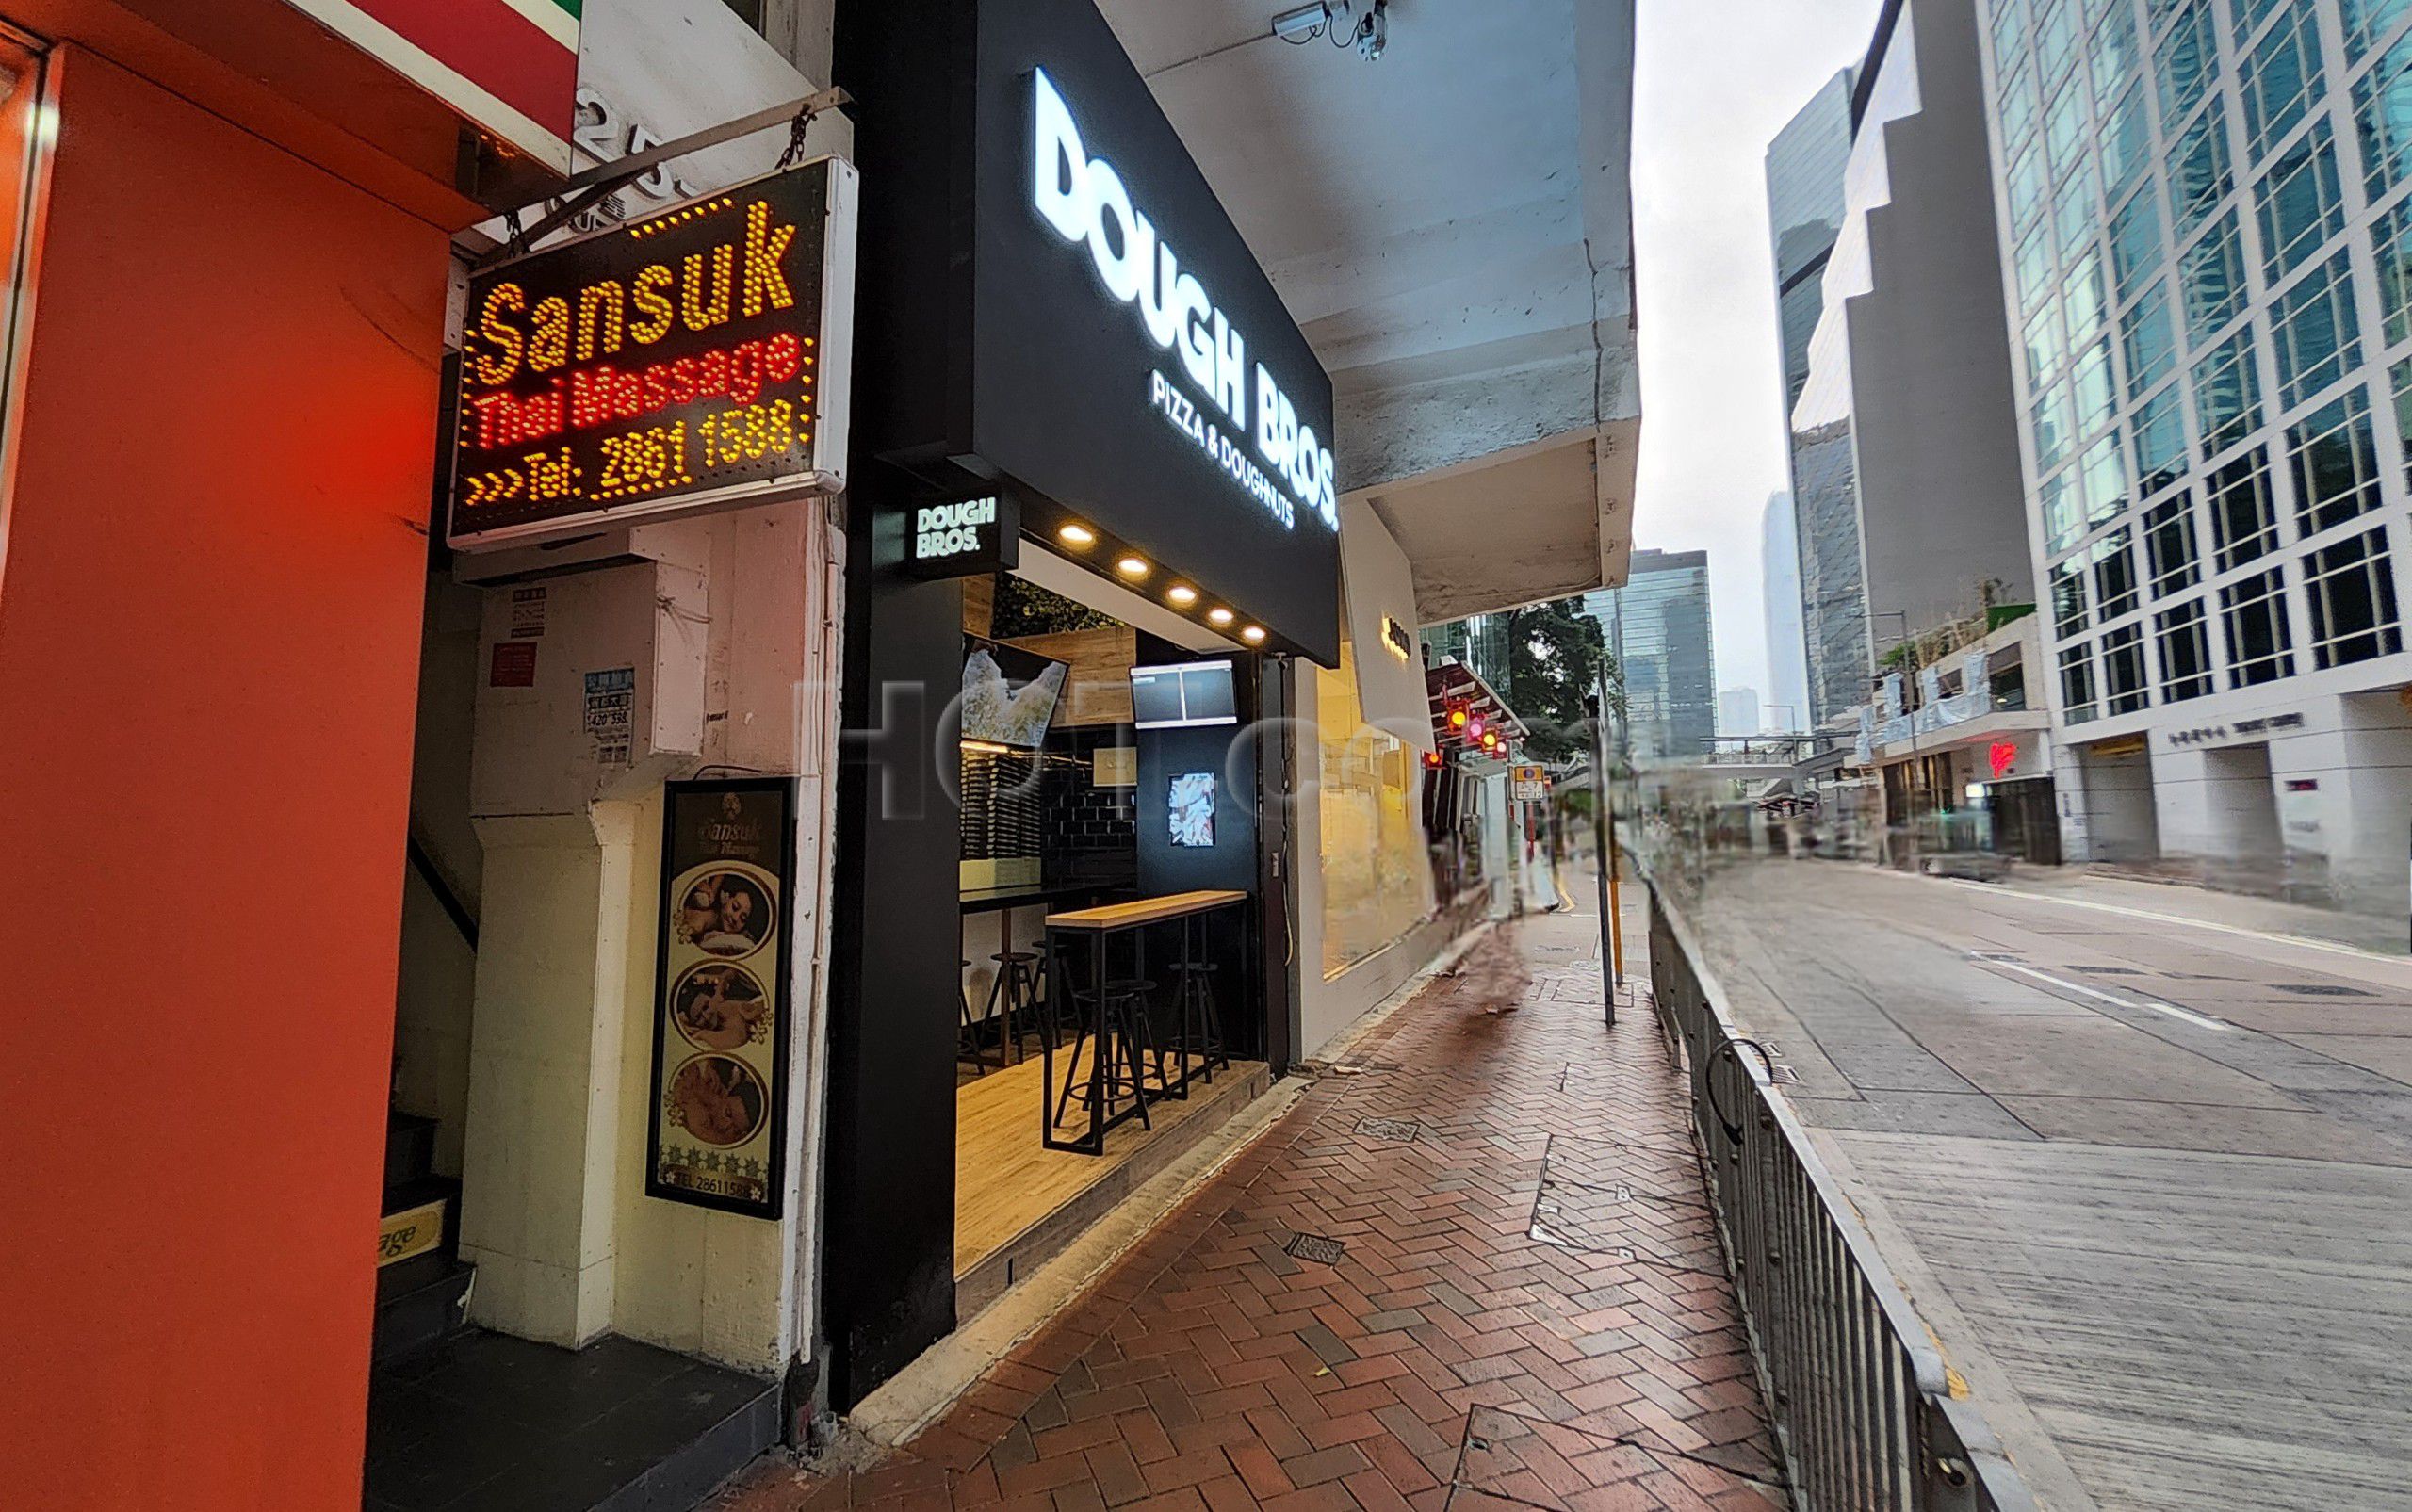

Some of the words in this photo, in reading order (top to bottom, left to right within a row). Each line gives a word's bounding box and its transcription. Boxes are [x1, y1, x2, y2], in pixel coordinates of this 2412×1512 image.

[476, 200, 796, 386] Sansuk
[1035, 65, 1246, 431] DOUGH
[474, 377, 564, 449] Thai
[571, 332, 801, 428] Massage
[697, 399, 793, 468] 1588
[1151, 368, 1205, 447] PIZZA
[1207, 423, 1219, 459] &
[1220, 435, 1296, 530] DOUGHNUTS
[916, 526, 981, 559] BROS.
[917, 496, 996, 533] DOUGH
